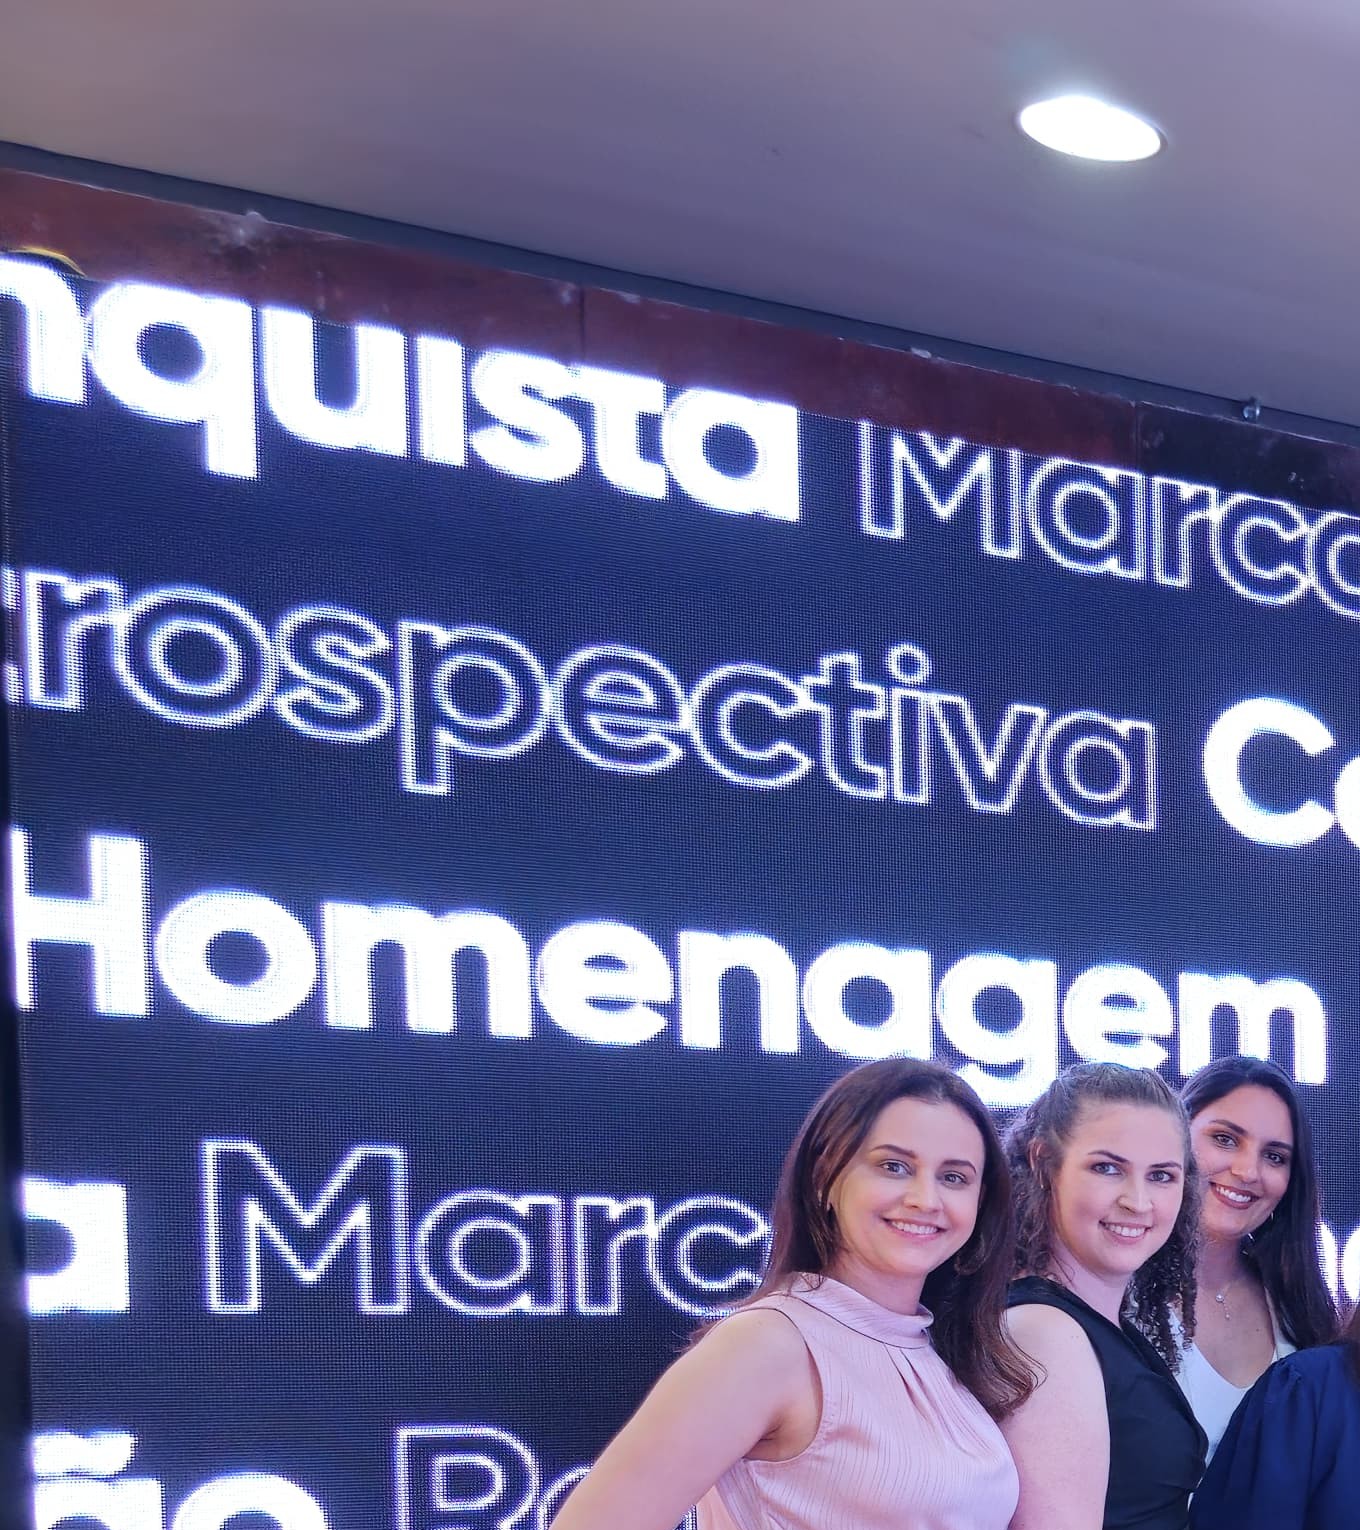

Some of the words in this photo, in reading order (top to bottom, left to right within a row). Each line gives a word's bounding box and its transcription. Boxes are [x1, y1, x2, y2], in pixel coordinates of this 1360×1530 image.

[2, 566, 1158, 833] rospectiva
[10, 826, 1328, 1109] Homenagem
[201, 1137, 775, 1317] Marc
